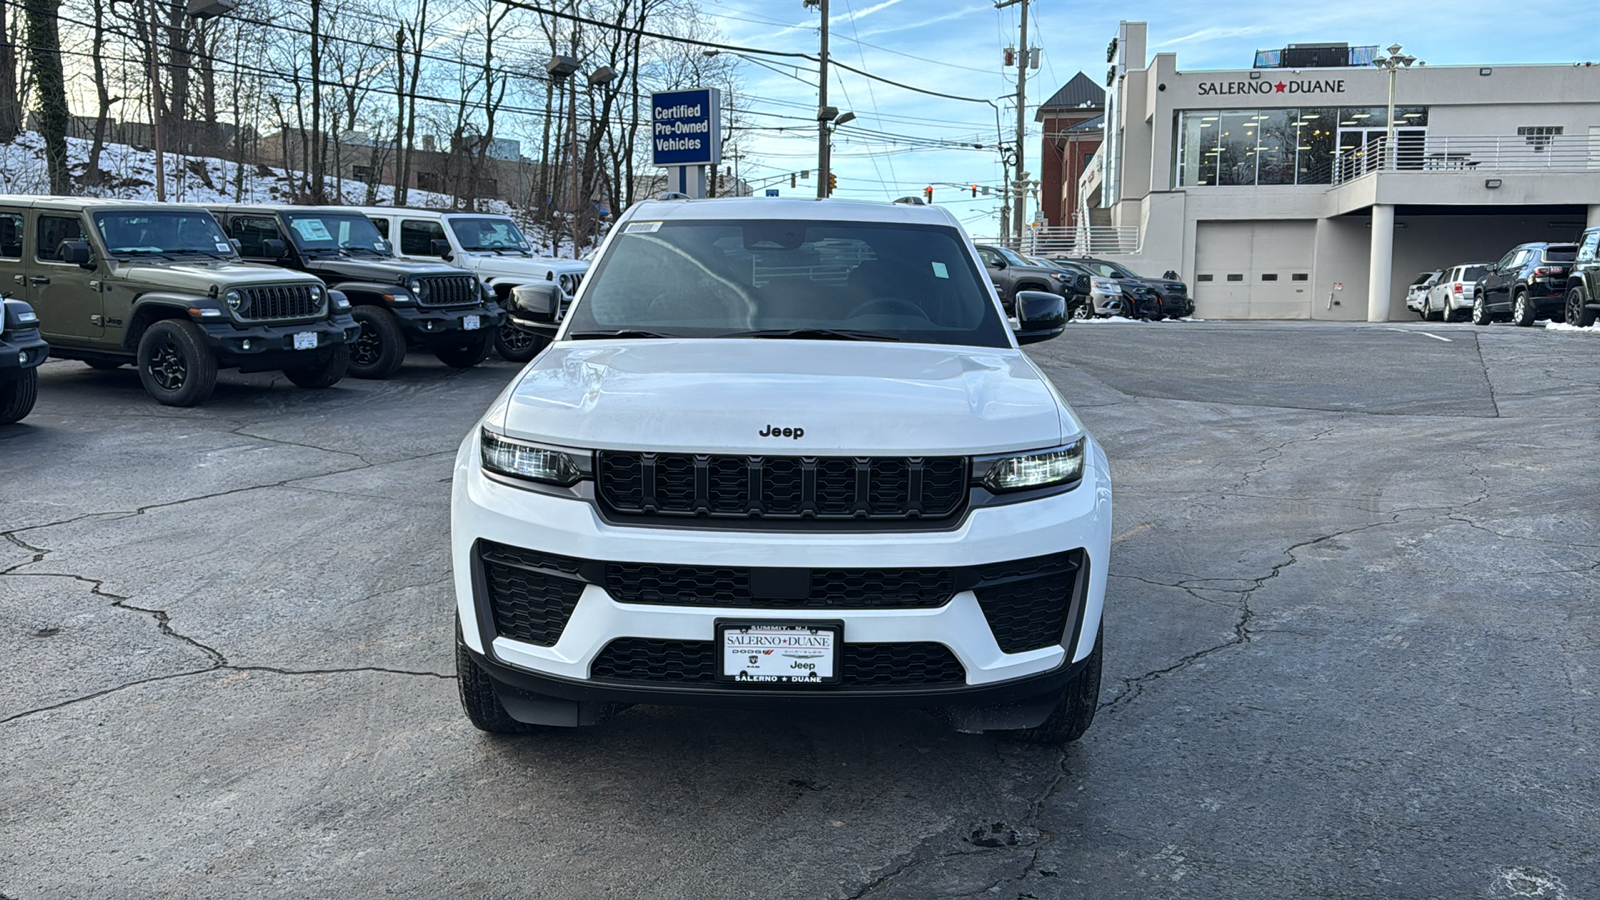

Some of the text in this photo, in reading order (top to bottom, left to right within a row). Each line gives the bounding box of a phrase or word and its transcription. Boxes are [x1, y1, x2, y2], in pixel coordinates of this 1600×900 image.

[1198, 80, 1345, 95] SALERNO DUANE
[655, 104, 701, 119] Certified
[655, 120, 708, 135] Pre-Owned
[656, 137, 701, 151] Vehicles
[759, 424, 805, 440] Jeep
[727, 635, 830, 647] SALERNO DUANE
[790, 660, 816, 671] Jeep
